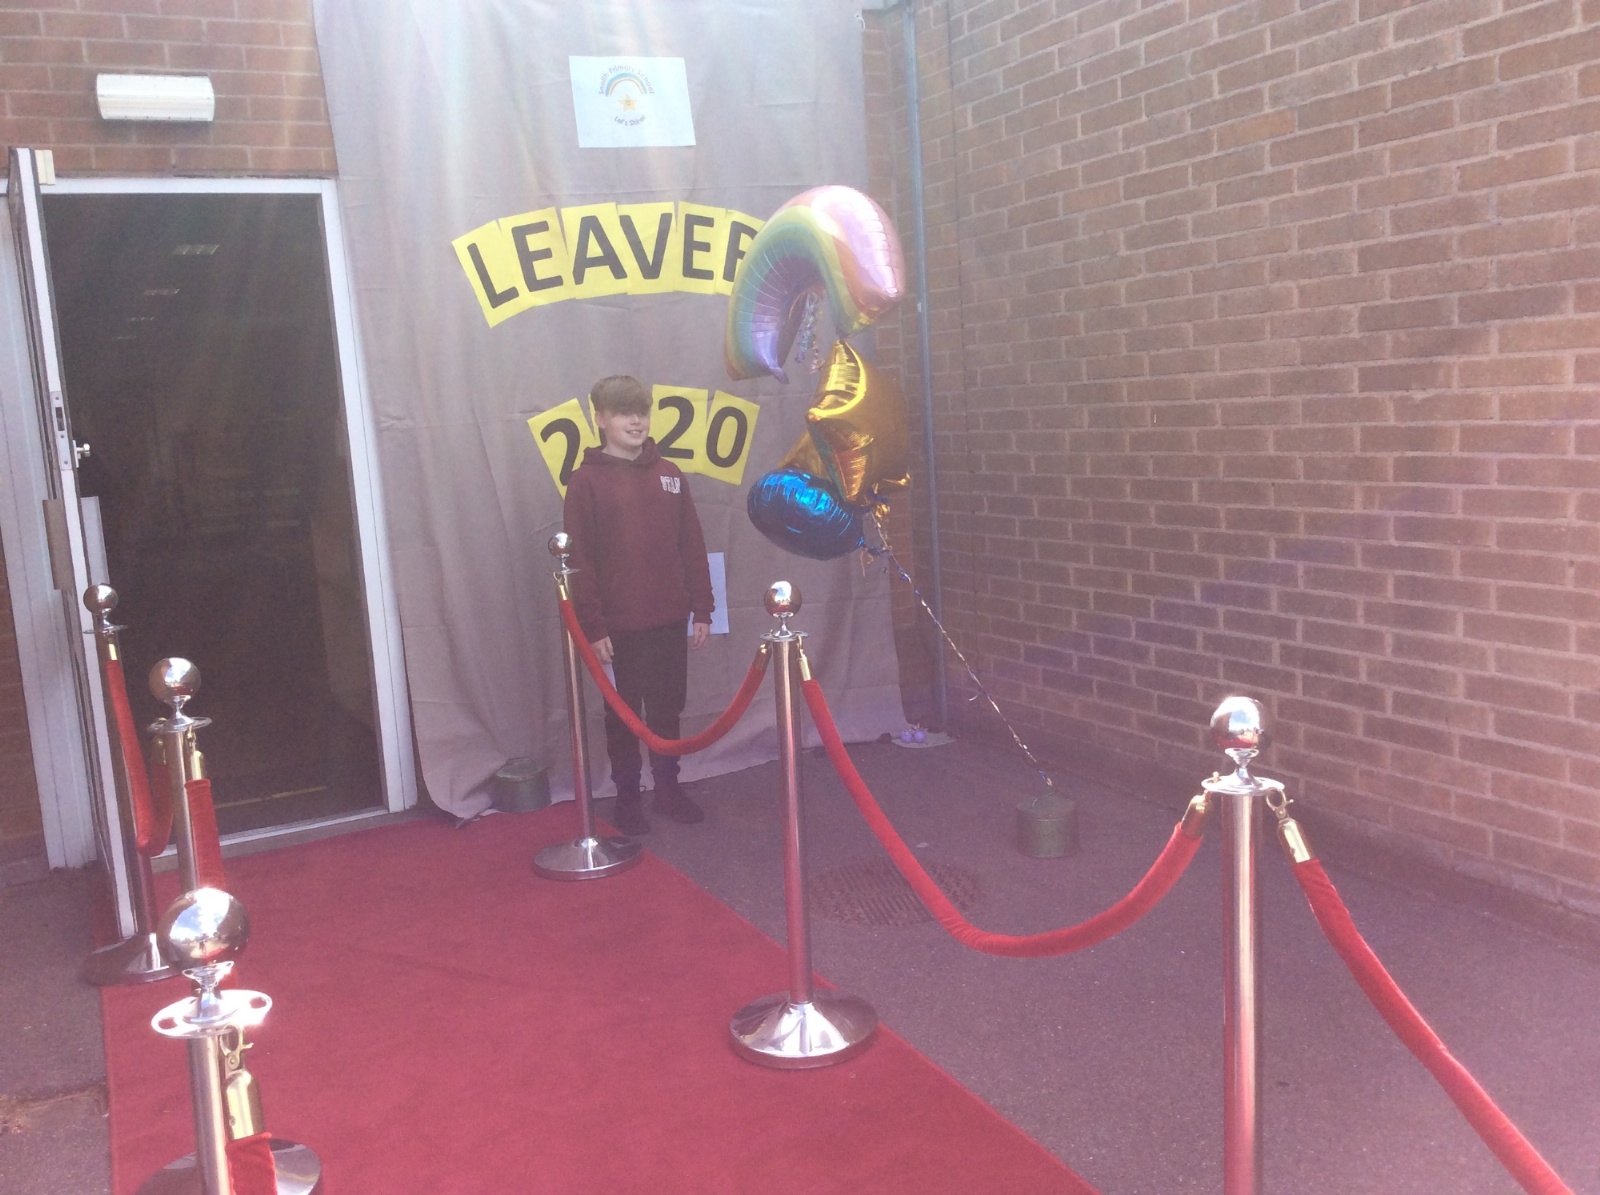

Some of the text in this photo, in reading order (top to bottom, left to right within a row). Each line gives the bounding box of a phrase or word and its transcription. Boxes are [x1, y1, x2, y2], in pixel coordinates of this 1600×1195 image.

[609, 65, 635, 74] Primary
[637, 69, 655, 94] School
[540, 395, 748, 487] 220
